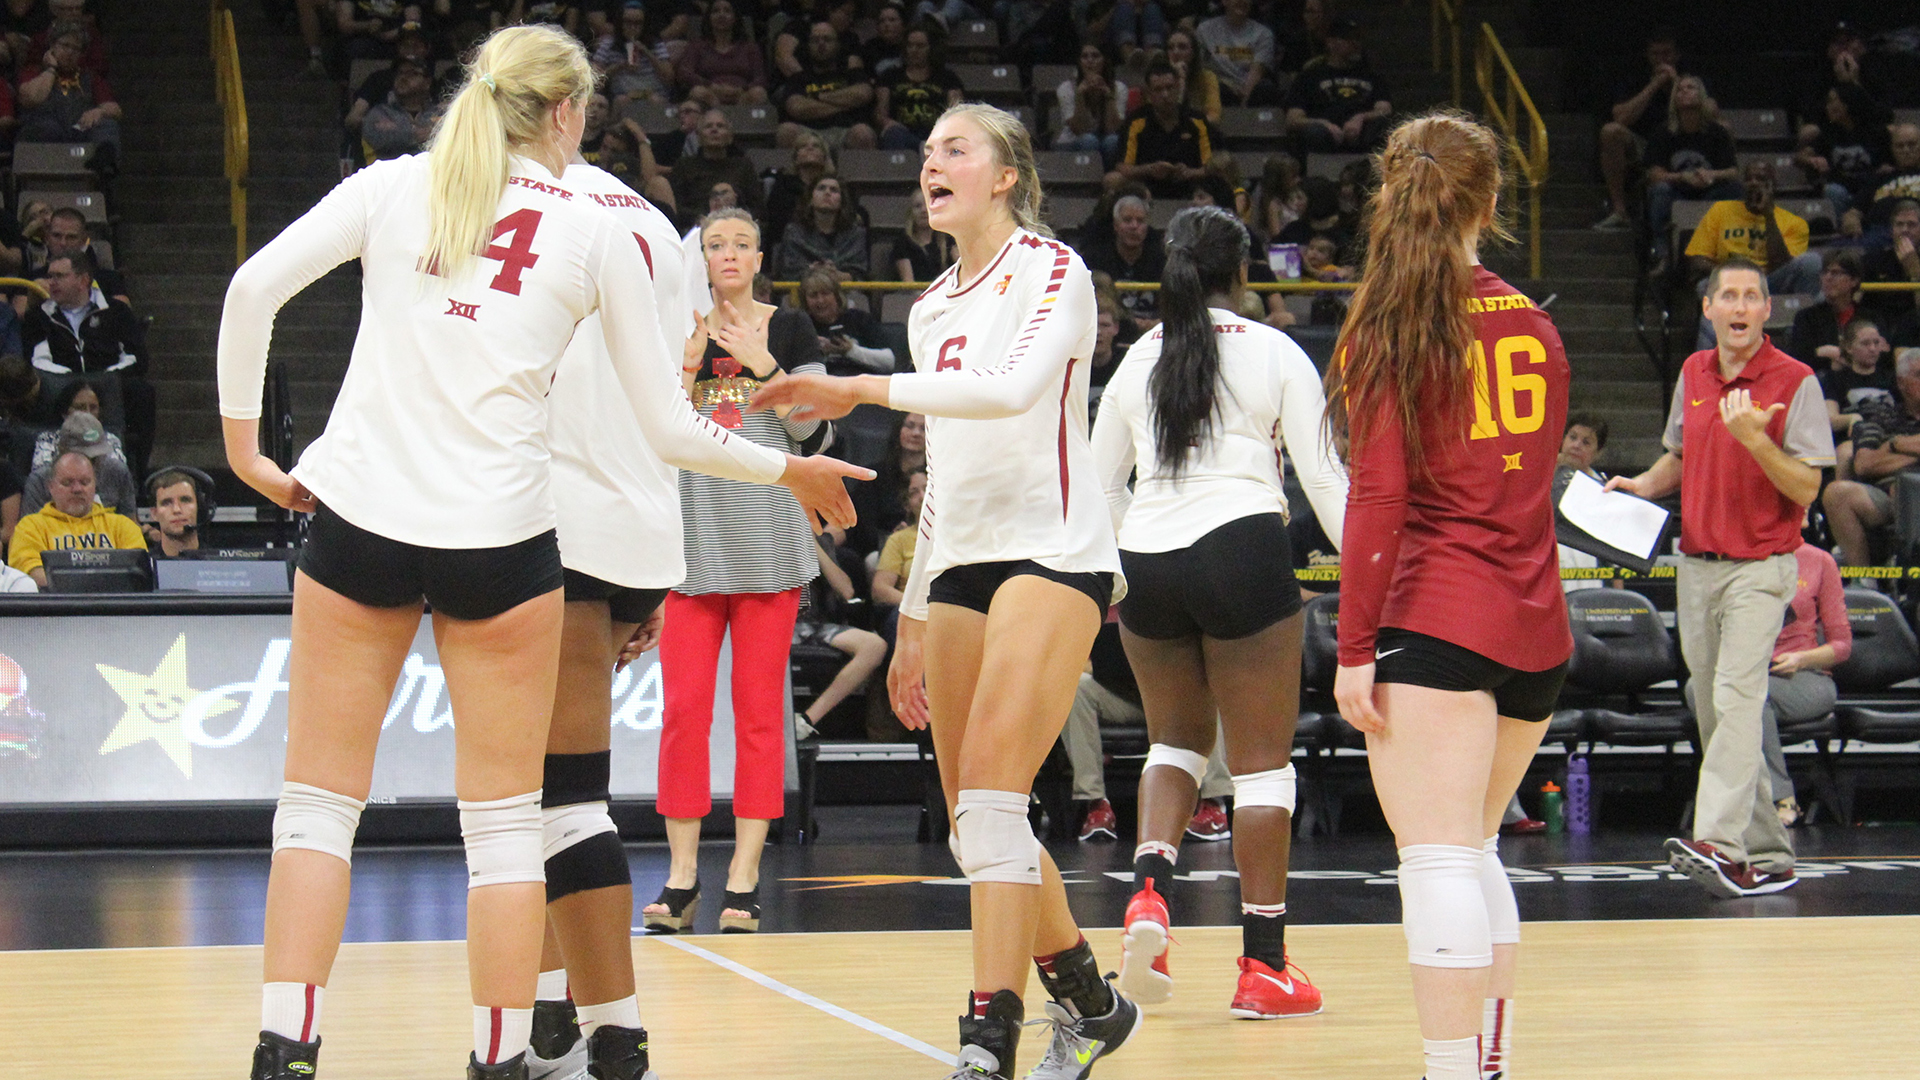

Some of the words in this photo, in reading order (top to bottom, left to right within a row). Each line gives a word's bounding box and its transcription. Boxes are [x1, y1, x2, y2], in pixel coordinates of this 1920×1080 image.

[604, 194, 651, 211] STATE
[444, 298, 481, 322] XII
[1466, 335, 1547, 440] 16
[1502, 452, 1523, 473] XII
[54, 533, 114, 551] IOWA
[1840, 567, 1902, 578] HAWKEYES
